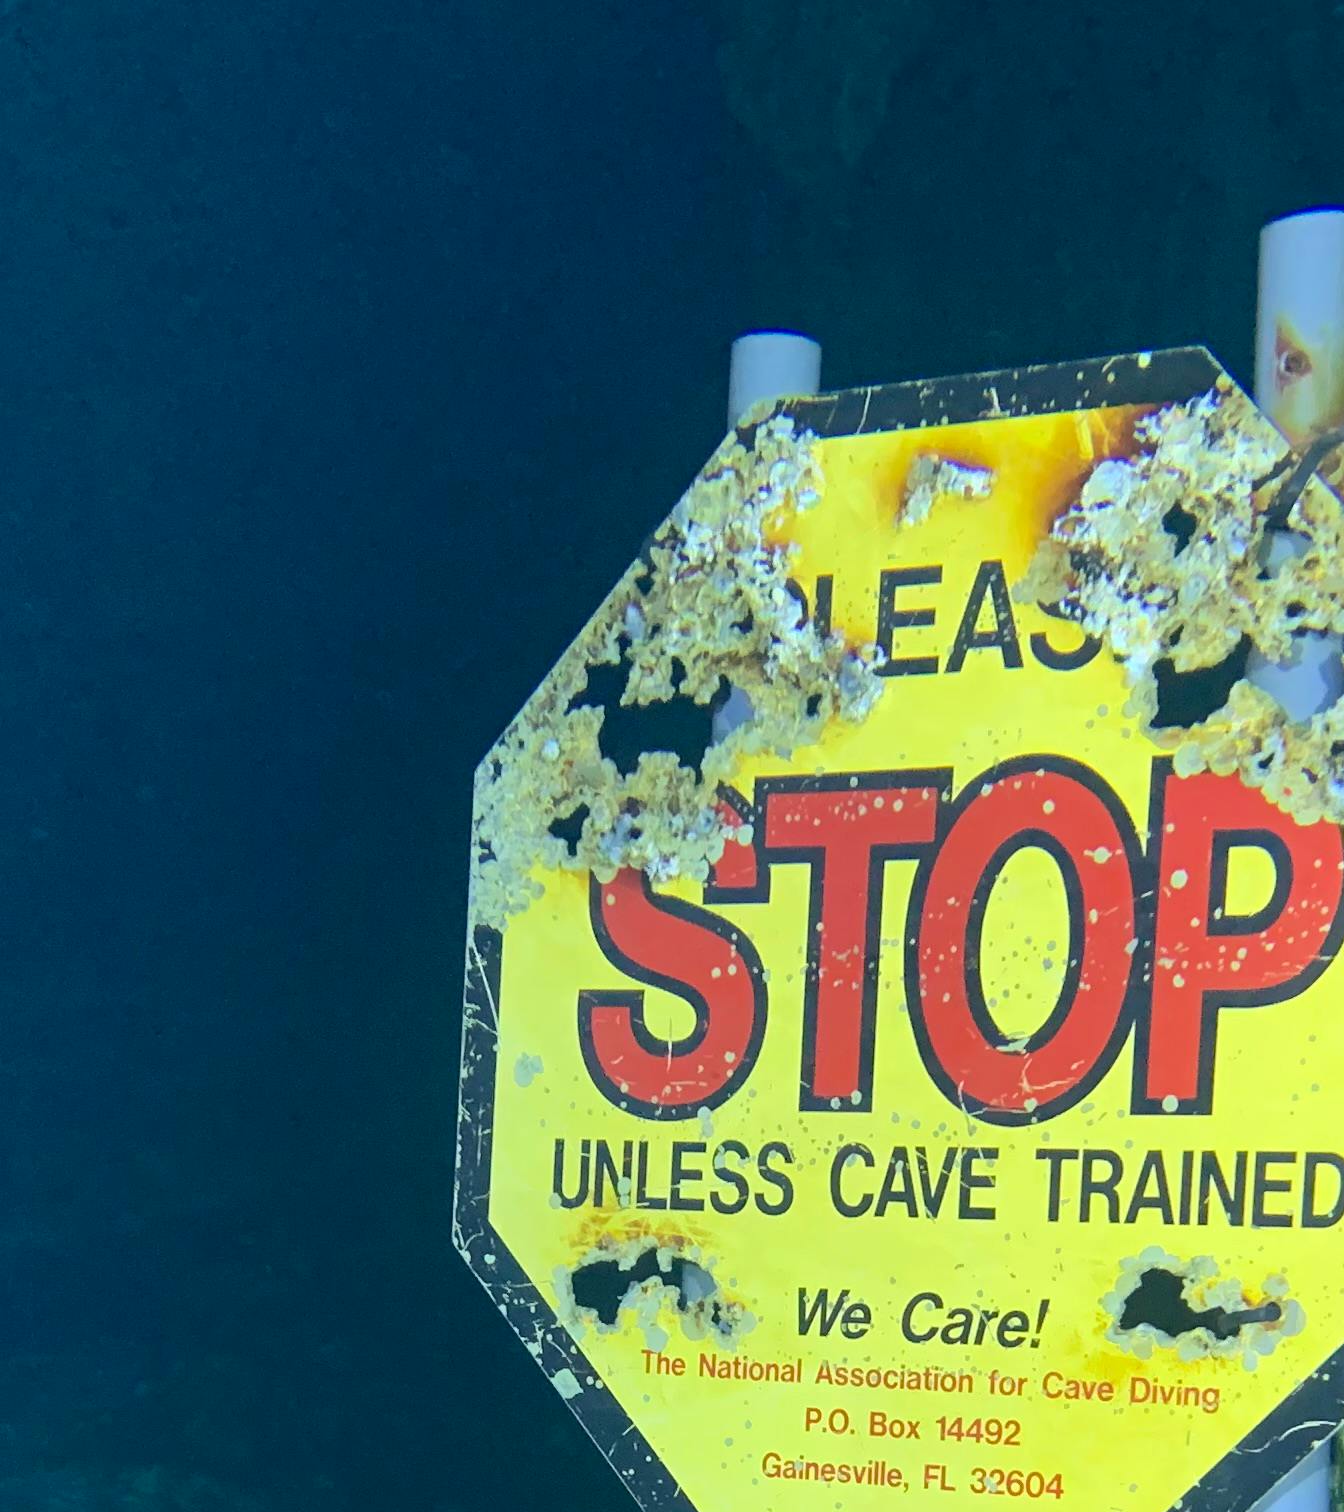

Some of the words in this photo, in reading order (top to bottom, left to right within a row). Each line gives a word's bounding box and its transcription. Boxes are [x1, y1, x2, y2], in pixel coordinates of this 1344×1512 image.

[784, 558, 1106, 678] LEAS
[552, 1138, 794, 1215] UNLESS
[829, 1142, 1000, 1221] CAVE
[798, 1287, 872, 1340] We
[901, 1291, 1051, 1349] Care!
[640, 1350, 686, 1377] The
[699, 1352, 802, 1384] National
[814, 1361, 974, 1394] Association
[987, 1369, 1029, 1397] for
[1042, 1371, 1115, 1402] Cave
[1128, 1376, 1220, 1414] Diving
[805, 1407, 856, 1435] P.O.
[869, 1411, 921, 1440] Box
[935, 1415, 1021, 1446] 14492
[761, 1451, 909, 1493] Gainesville,
[923, 1463, 957, 1492] FL
[969, 1467, 1065, 1500] 32604
